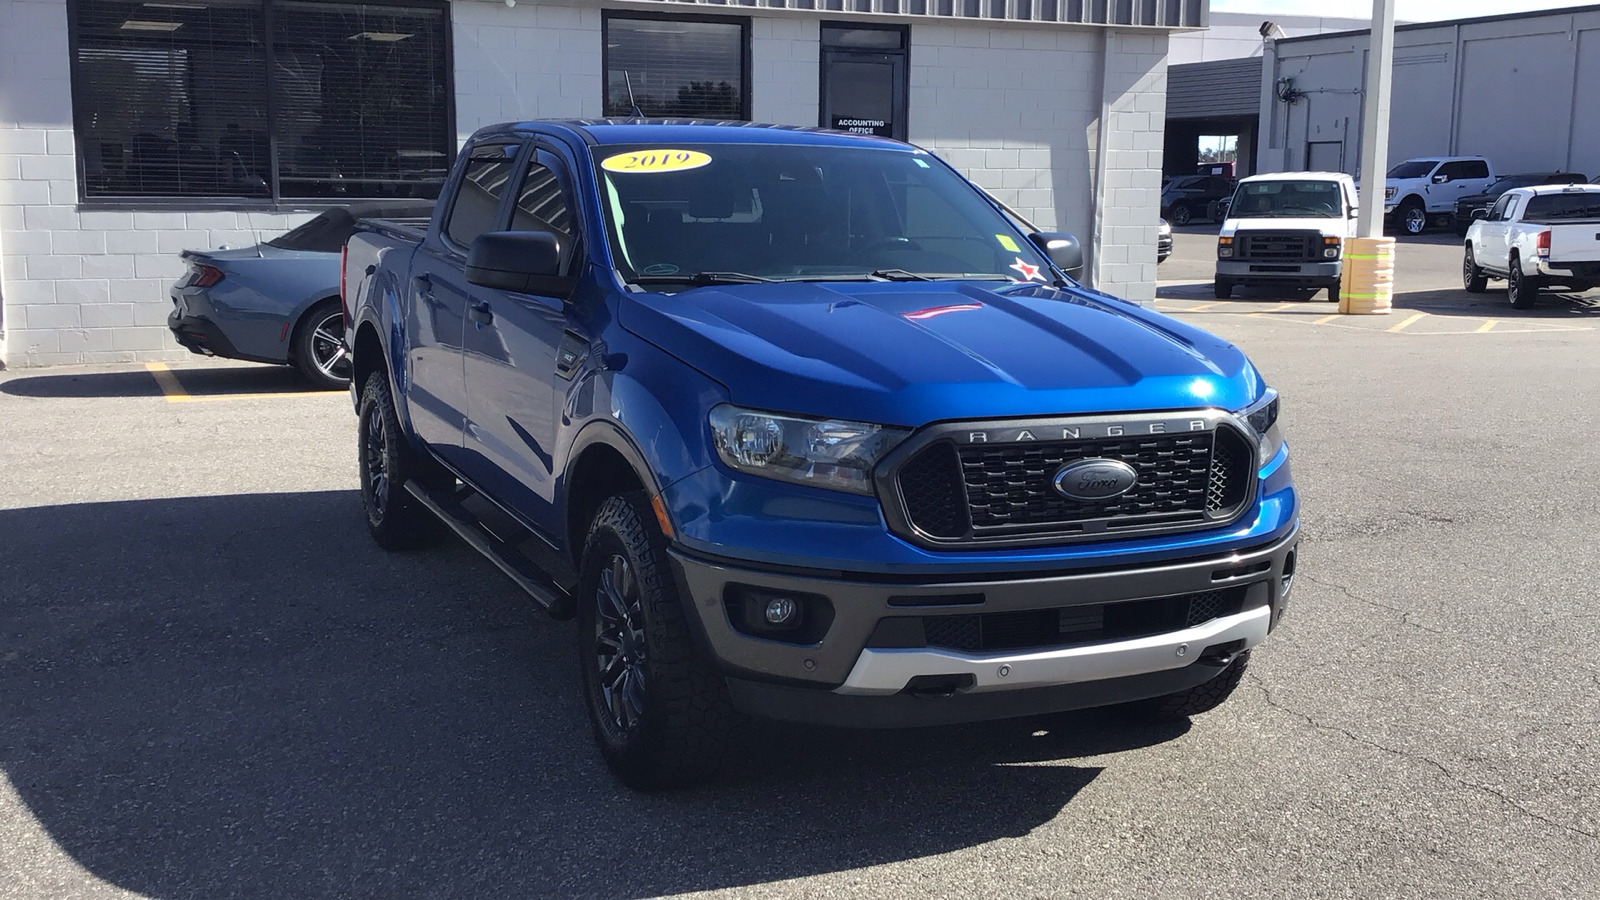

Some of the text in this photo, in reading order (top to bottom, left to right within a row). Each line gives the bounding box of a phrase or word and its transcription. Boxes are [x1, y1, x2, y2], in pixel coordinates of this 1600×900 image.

[838, 119, 885, 127] ACCOUNTING
[624, 153, 690, 168] 2019
[969, 420, 1205, 442] RANGER
[1079, 470, 1120, 490] Ford
